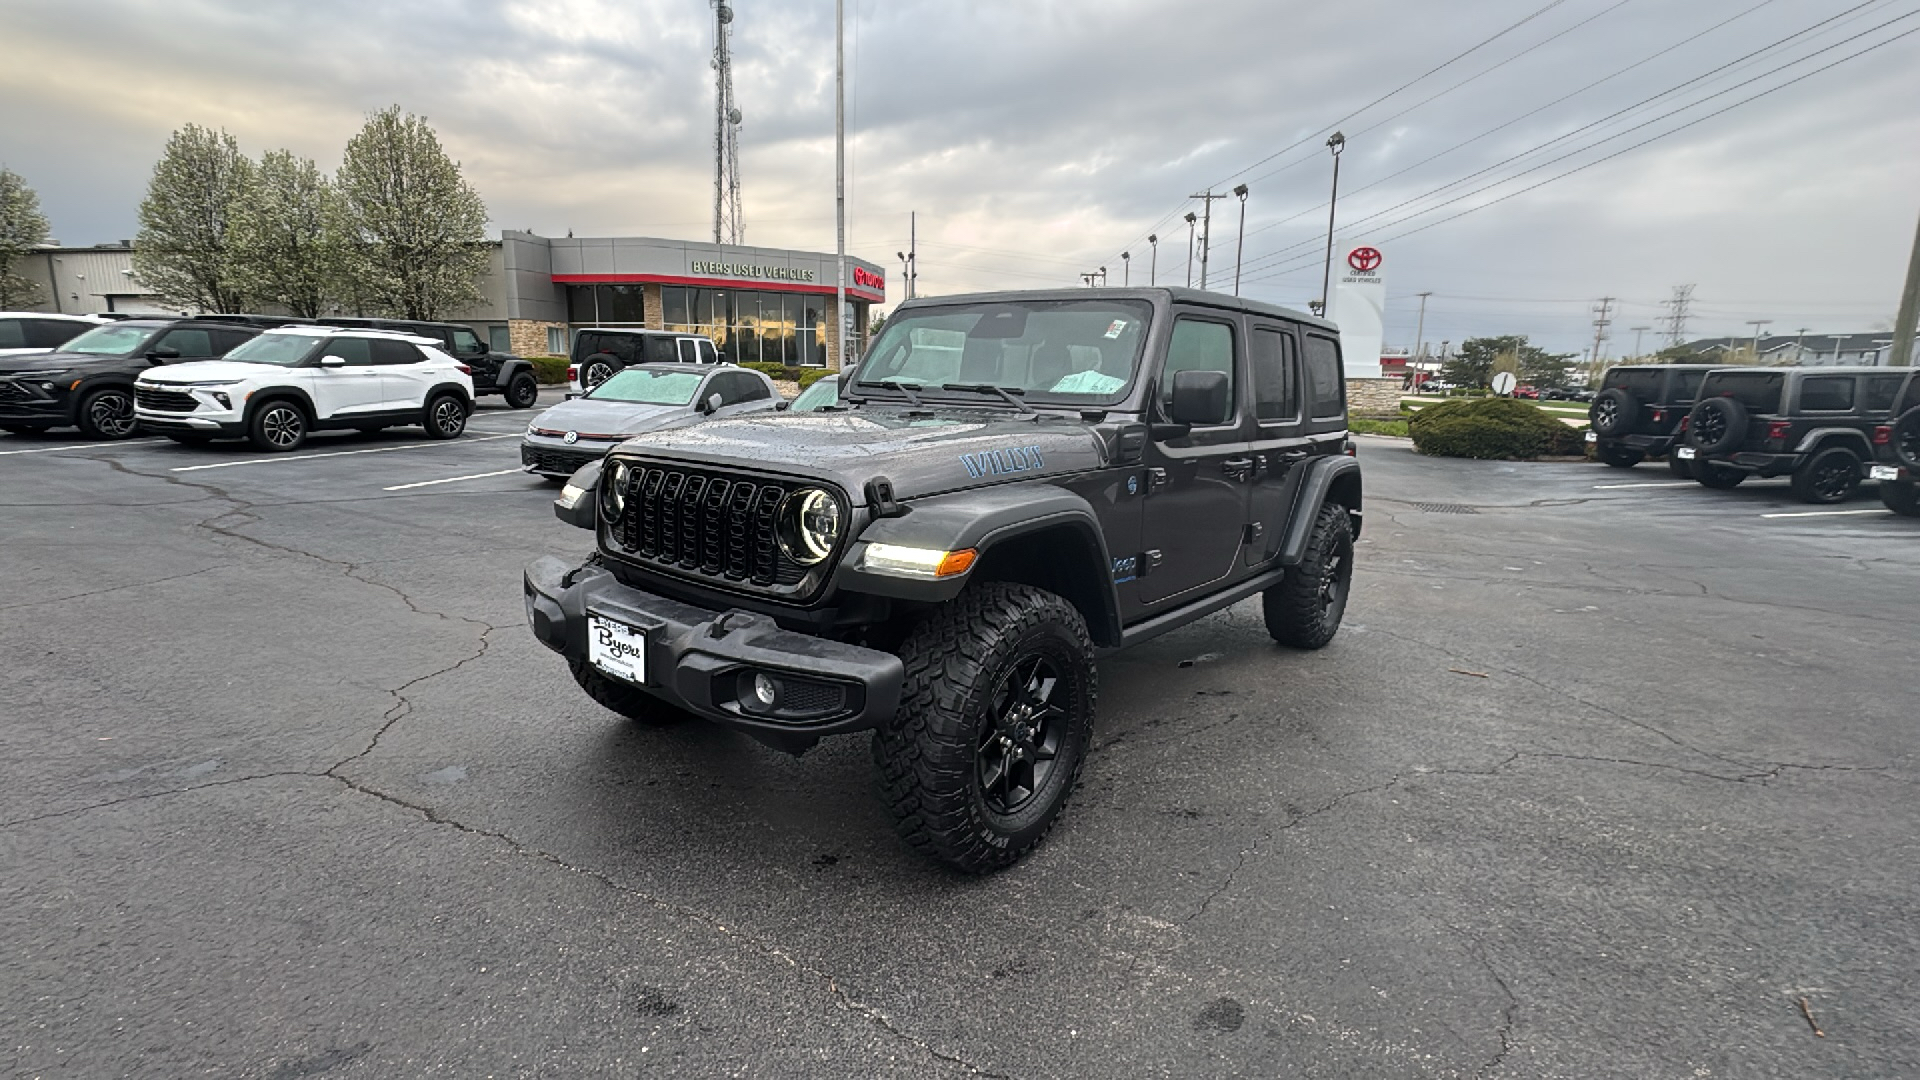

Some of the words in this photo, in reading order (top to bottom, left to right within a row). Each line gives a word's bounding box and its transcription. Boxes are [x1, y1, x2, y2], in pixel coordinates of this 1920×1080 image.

[692, 260, 730, 275] BYERS
[733, 264, 762, 277] USED
[764, 266, 814, 282] VEHICLES
[958, 445, 1044, 479] WILLYS
[1111, 557, 1136, 574] Jeep
[593, 625, 640, 659] Byers
